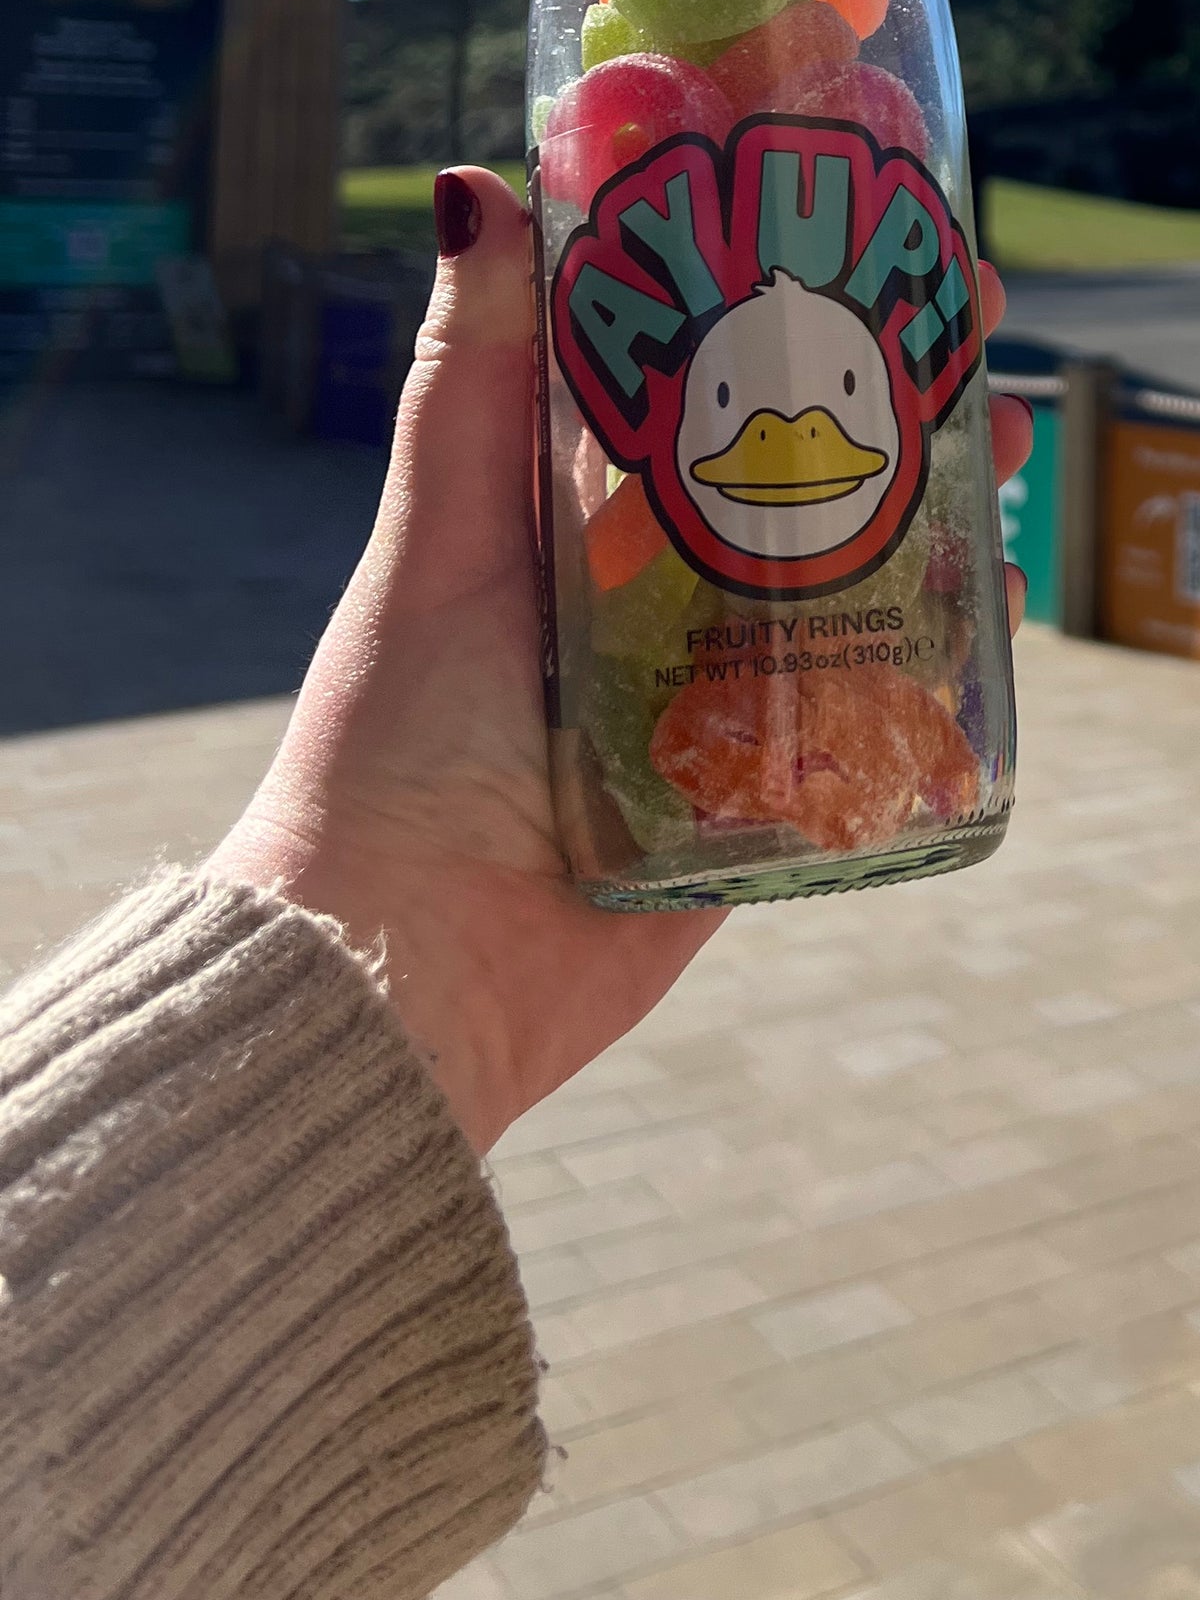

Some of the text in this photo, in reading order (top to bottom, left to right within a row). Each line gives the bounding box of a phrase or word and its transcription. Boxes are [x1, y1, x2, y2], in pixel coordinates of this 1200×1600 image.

[568, 170, 727, 399] AY
[687, 607, 904, 653] FRUITY RINGS
[655, 660, 696, 688] NET
[705, 659, 744, 683] WT
